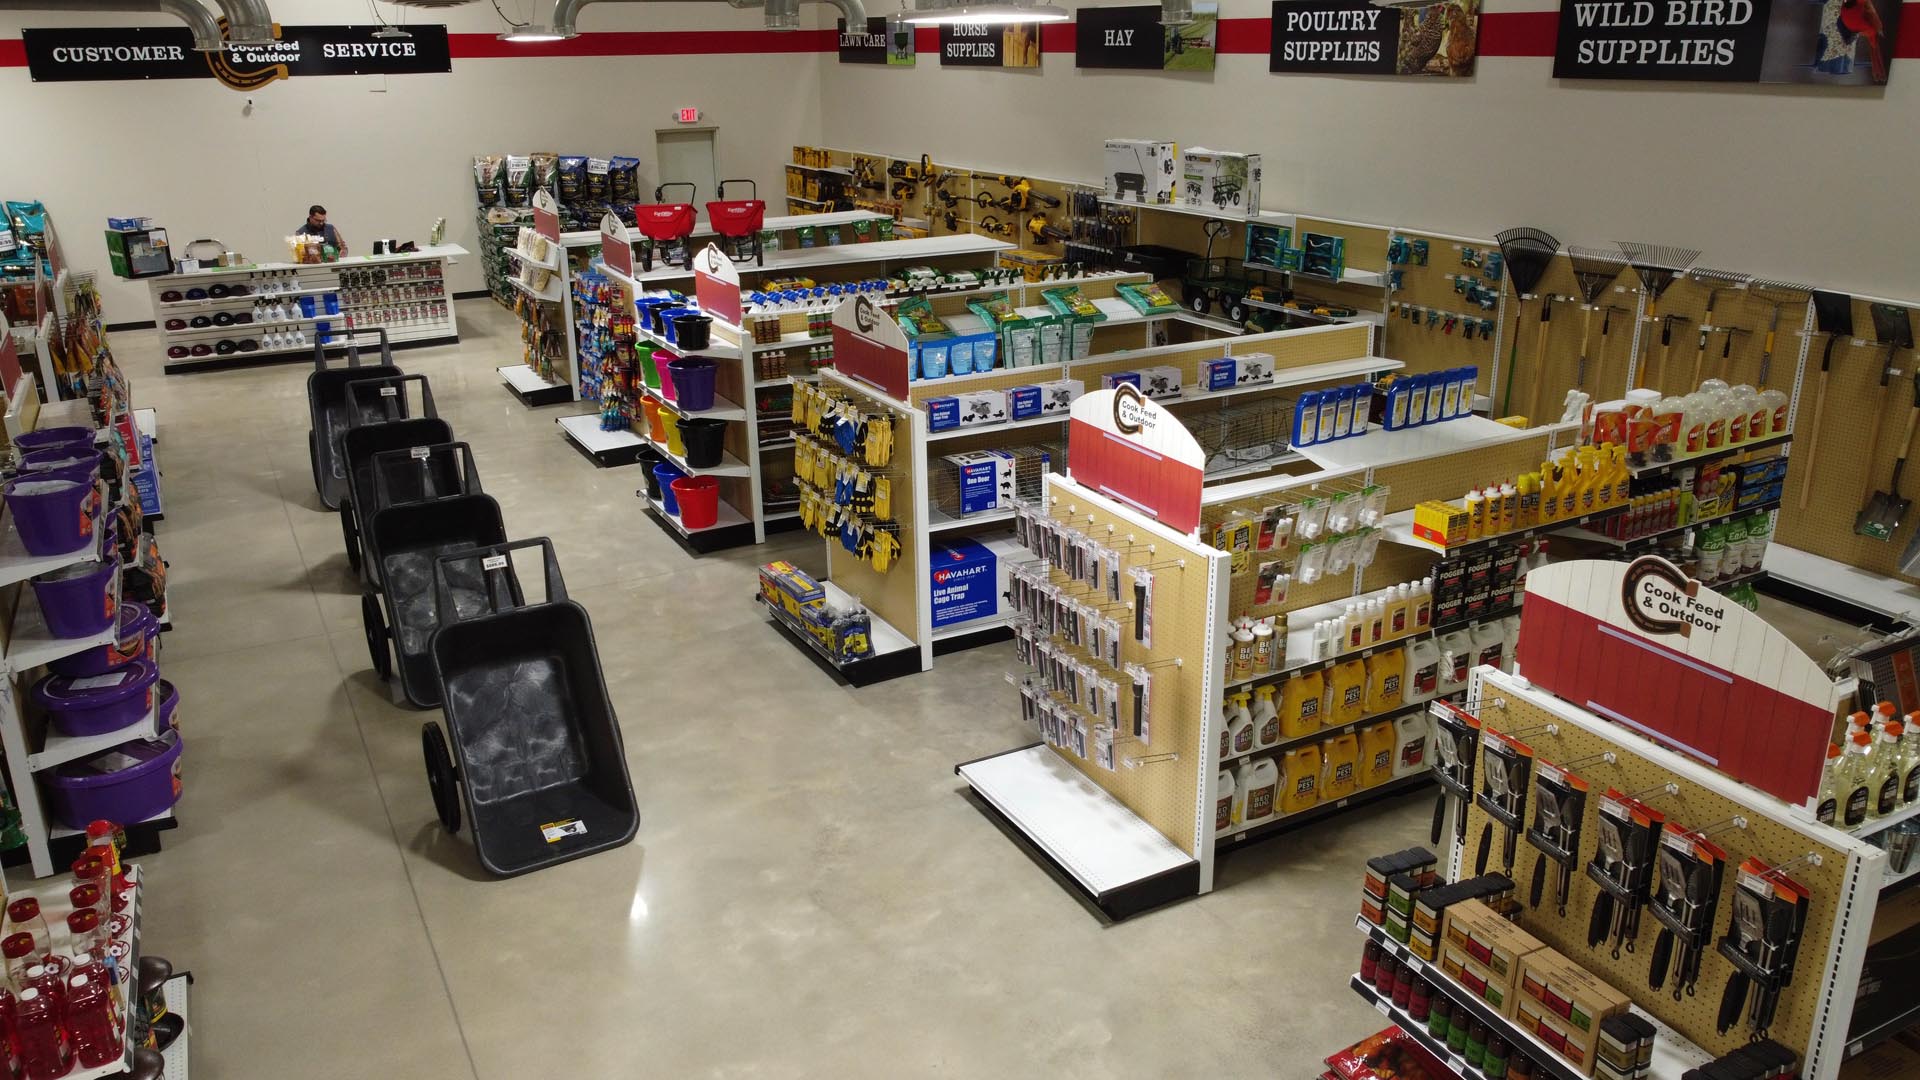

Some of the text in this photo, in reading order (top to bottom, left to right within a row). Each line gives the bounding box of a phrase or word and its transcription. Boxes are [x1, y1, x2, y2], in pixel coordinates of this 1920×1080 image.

[1574, 0, 1753, 27] WILD BIRD
[1286, 10, 1381, 31] POULTRY
[953, 23, 988, 37] HORSE
[839, 34, 886, 47] LAWN CARE
[1104, 29, 1135, 46] HAY
[52, 46, 185, 62] CUSTOMER
[323, 42, 416, 58] SERVICE
[946, 42, 996, 58] SUPPLIES
[1283, 41, 1381, 62] SUPPLIES
[1577, 39, 1736, 66] SUPPLIES
[231, 52, 301, 63] & Outdoor
[681, 108, 697, 121] EXIT
[1122, 400, 1157, 420] Cook Feed
[1129, 412, 1156, 429] Outdoor
[1468, 561, 1492, 574] FOGGER
[1495, 555, 1518, 567] FOGGER
[938, 565, 987, 581] HAVAHART
[1439, 568, 1465, 580] FOGGER
[933, 583, 969, 597] Live Animal
[1490, 585, 1515, 597] FOGGER
[933, 592, 965, 605] Cage Trap
[1464, 592, 1489, 604] FOGGER
[1644, 582, 1682, 604] Cook
[1686, 597, 1724, 620] Feed
[1437, 599, 1462, 611] FOGGER
[1642, 596, 1654, 609] &
[1658, 602, 1722, 633] Outdoor
[1384, 680, 1399, 689] PEST
[1345, 692, 1360, 701] PEST
[1302, 705, 1317, 714] PEST
[1375, 755, 1389, 764] PEST
[1336, 768, 1352, 777] PEST
[1297, 780, 1314, 790] PEST
